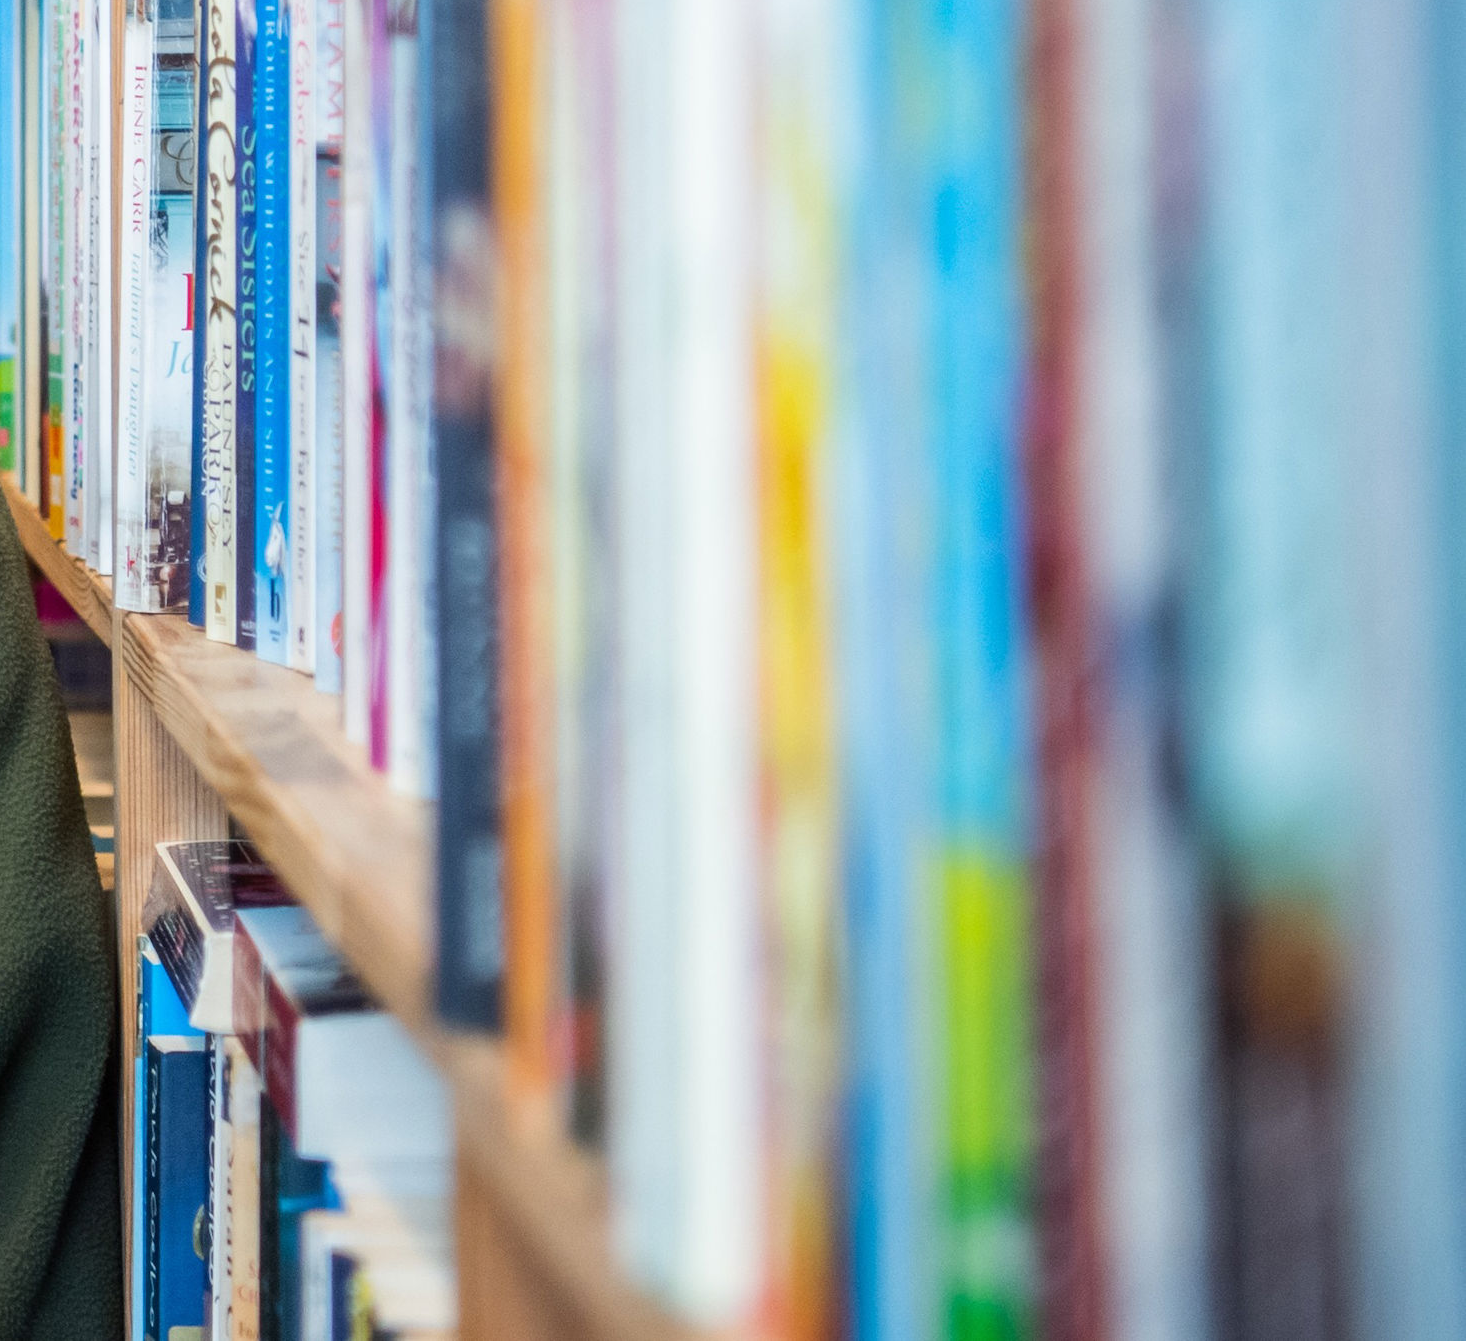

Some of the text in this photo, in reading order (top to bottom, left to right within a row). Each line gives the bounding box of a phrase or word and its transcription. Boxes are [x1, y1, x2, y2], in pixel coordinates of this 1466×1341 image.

[134, 65, 147, 146] IRENE
[264, 0, 275, 138] TROUBLE
[132, 157, 146, 234] CARR
[240, 124, 259, 215] Sea
[264, 151, 275, 230] WITH
[207, 120, 236, 325] Cornick
[240, 225, 258, 393] Sisters
[264, 241, 275, 340] GOATS
[264, 354, 275, 417] AND
[208, 398, 221, 498] PARK
[222, 343, 233, 555] DAUNTSEY
[150, 1190, 159, 1328] Coelho
